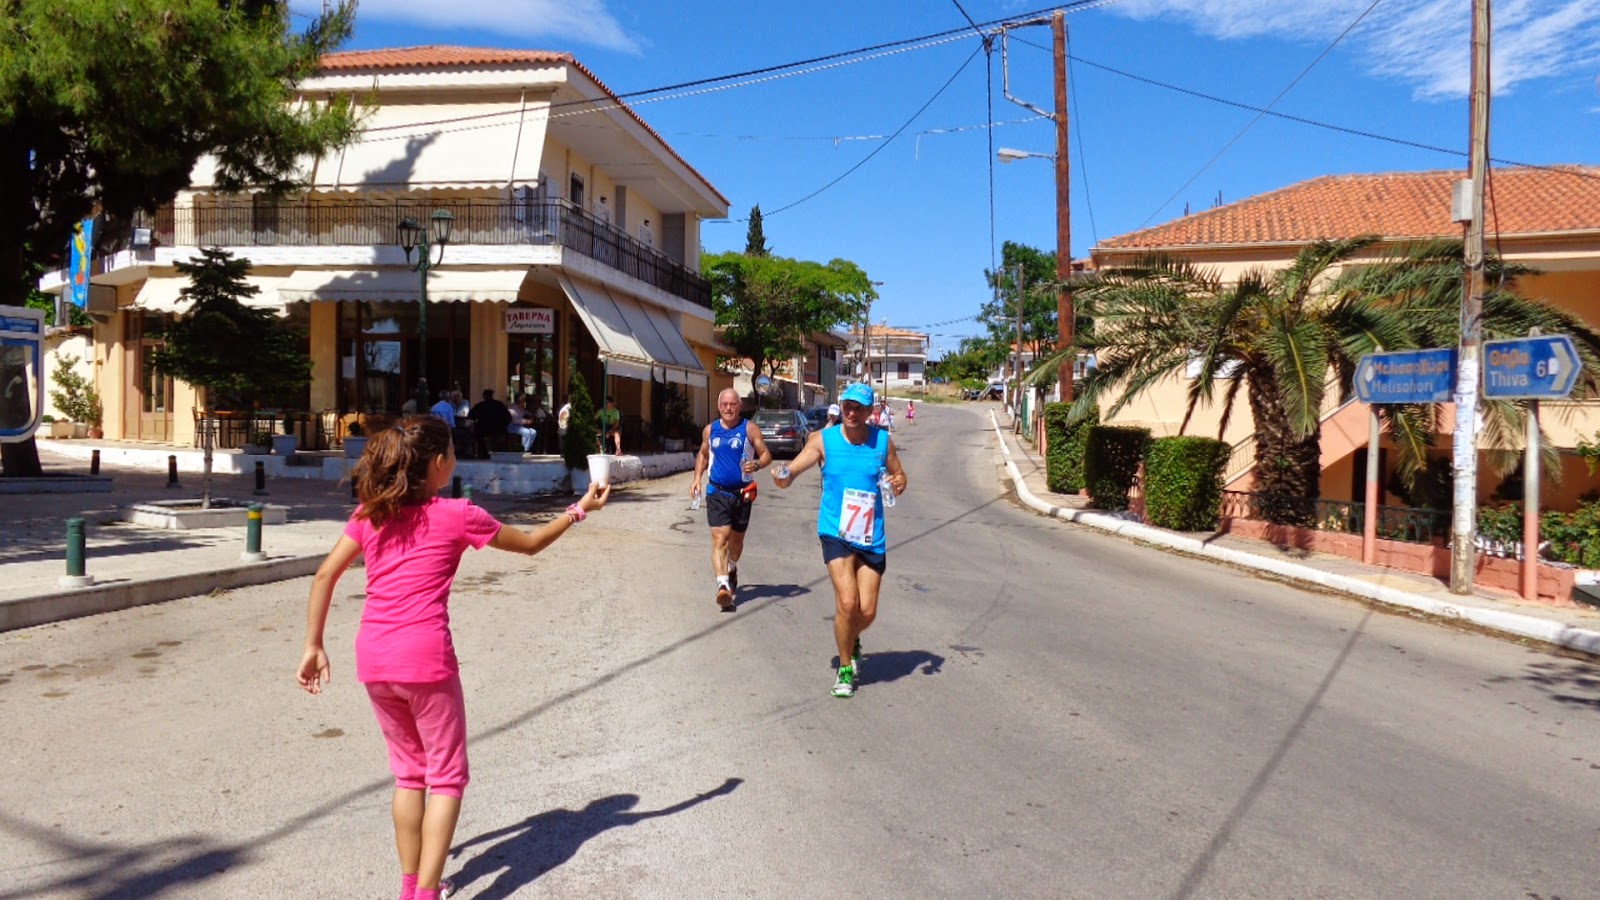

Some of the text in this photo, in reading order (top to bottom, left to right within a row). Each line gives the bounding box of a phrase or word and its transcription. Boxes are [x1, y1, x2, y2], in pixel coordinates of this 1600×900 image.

[506, 311, 550, 323] ΤΑΒΕΡΝΑ
[1489, 347, 1530, 369] Θήβα
[1536, 360, 1546, 378] 6
[1371, 379, 1433, 393] Melisohori
[1490, 371, 1528, 387] Thiva
[846, 503, 874, 535] 71
